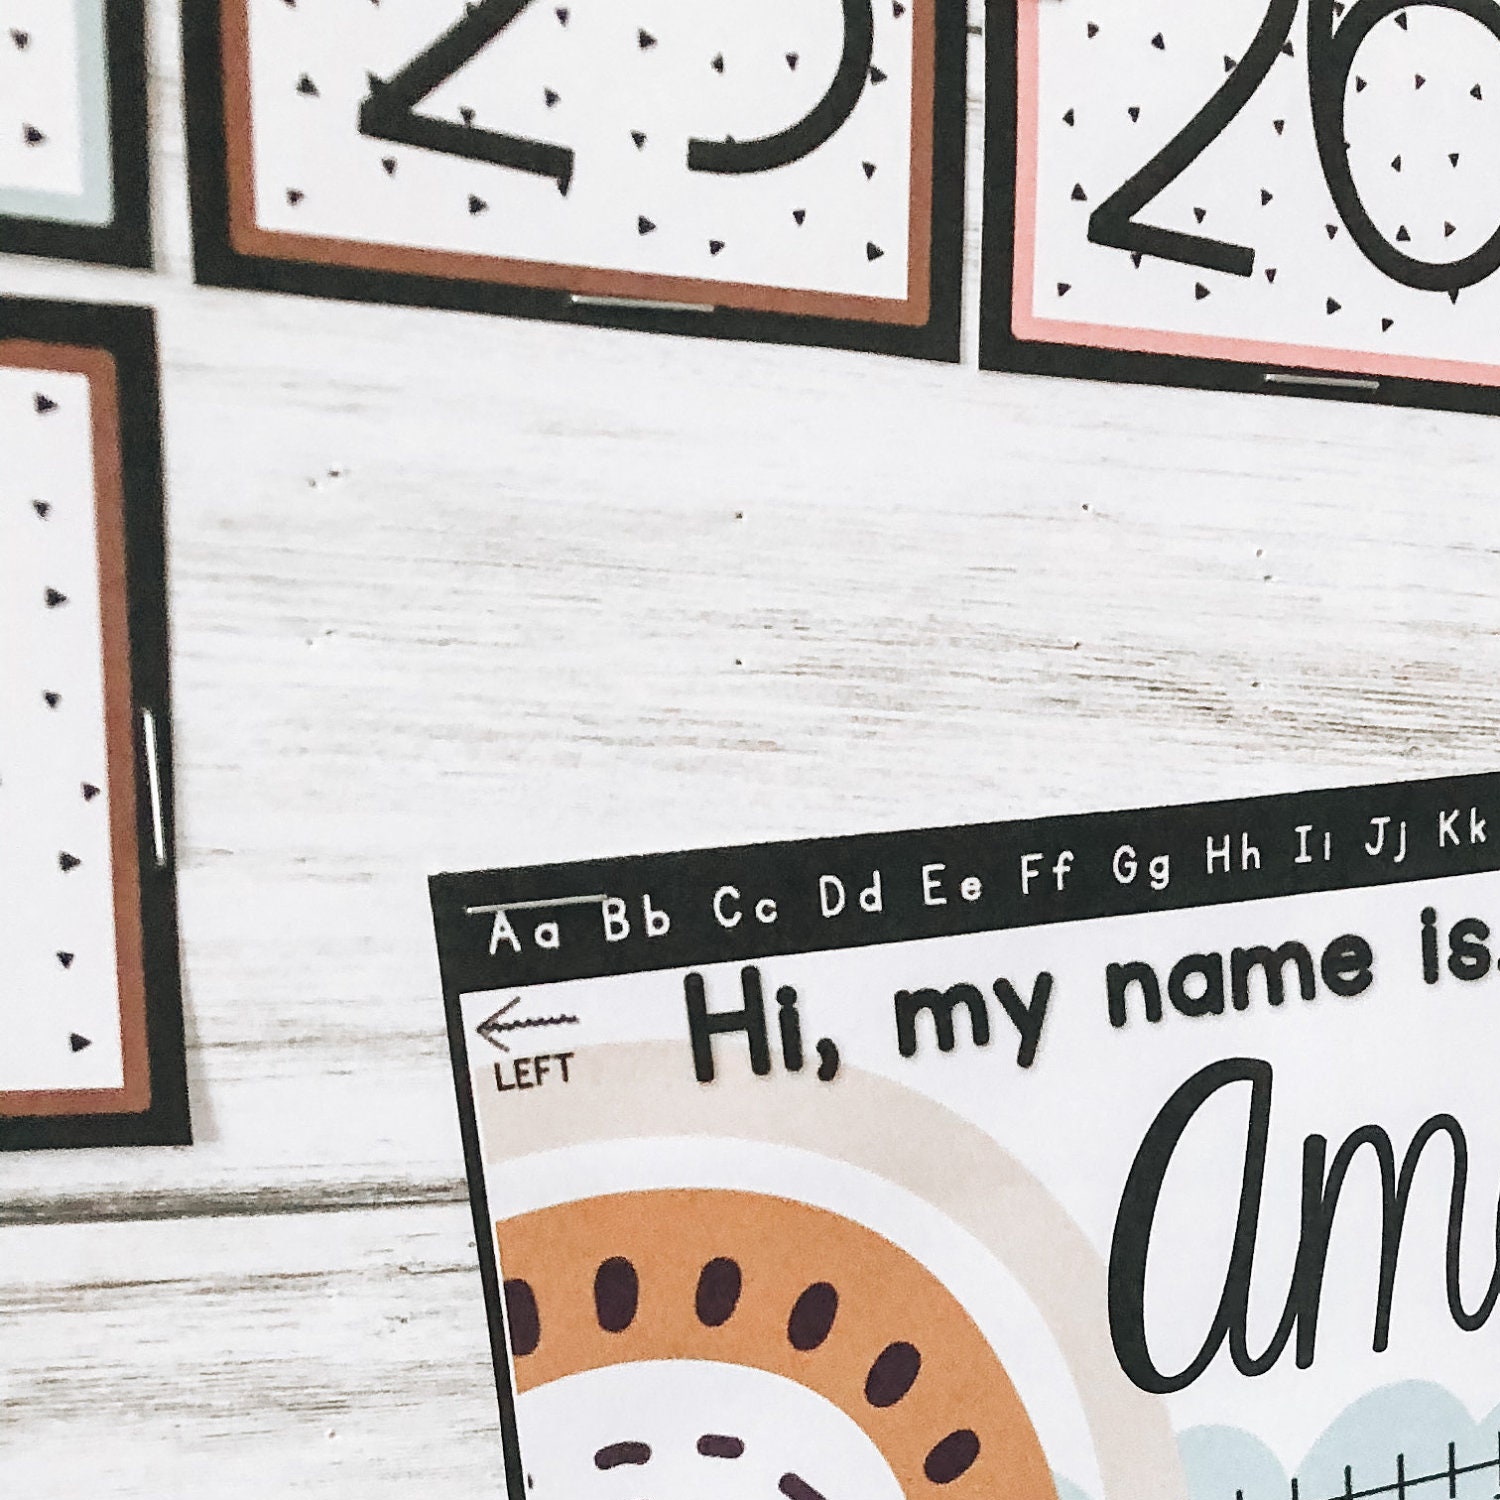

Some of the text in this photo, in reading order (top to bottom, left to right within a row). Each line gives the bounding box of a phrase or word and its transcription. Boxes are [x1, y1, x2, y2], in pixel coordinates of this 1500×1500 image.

[489, 909, 560, 956] Aa
[602, 893, 671, 943] Bb
[713, 885, 778, 928] Cc
[819, 869, 883, 919] Dd
[922, 863, 982, 906] Ee
[1020, 850, 1075, 895] Ff
[1112, 844, 1170, 891] Gg
[1206, 831, 1261, 874] Hh
[1439, 806, 1487, 848] Kk
[493, 1051, 575, 1092] LEFT
[683, 965, 841, 1085] Hi,
[893, 971, 1055, 1069] my
[1105, 933, 1375, 1030] name
